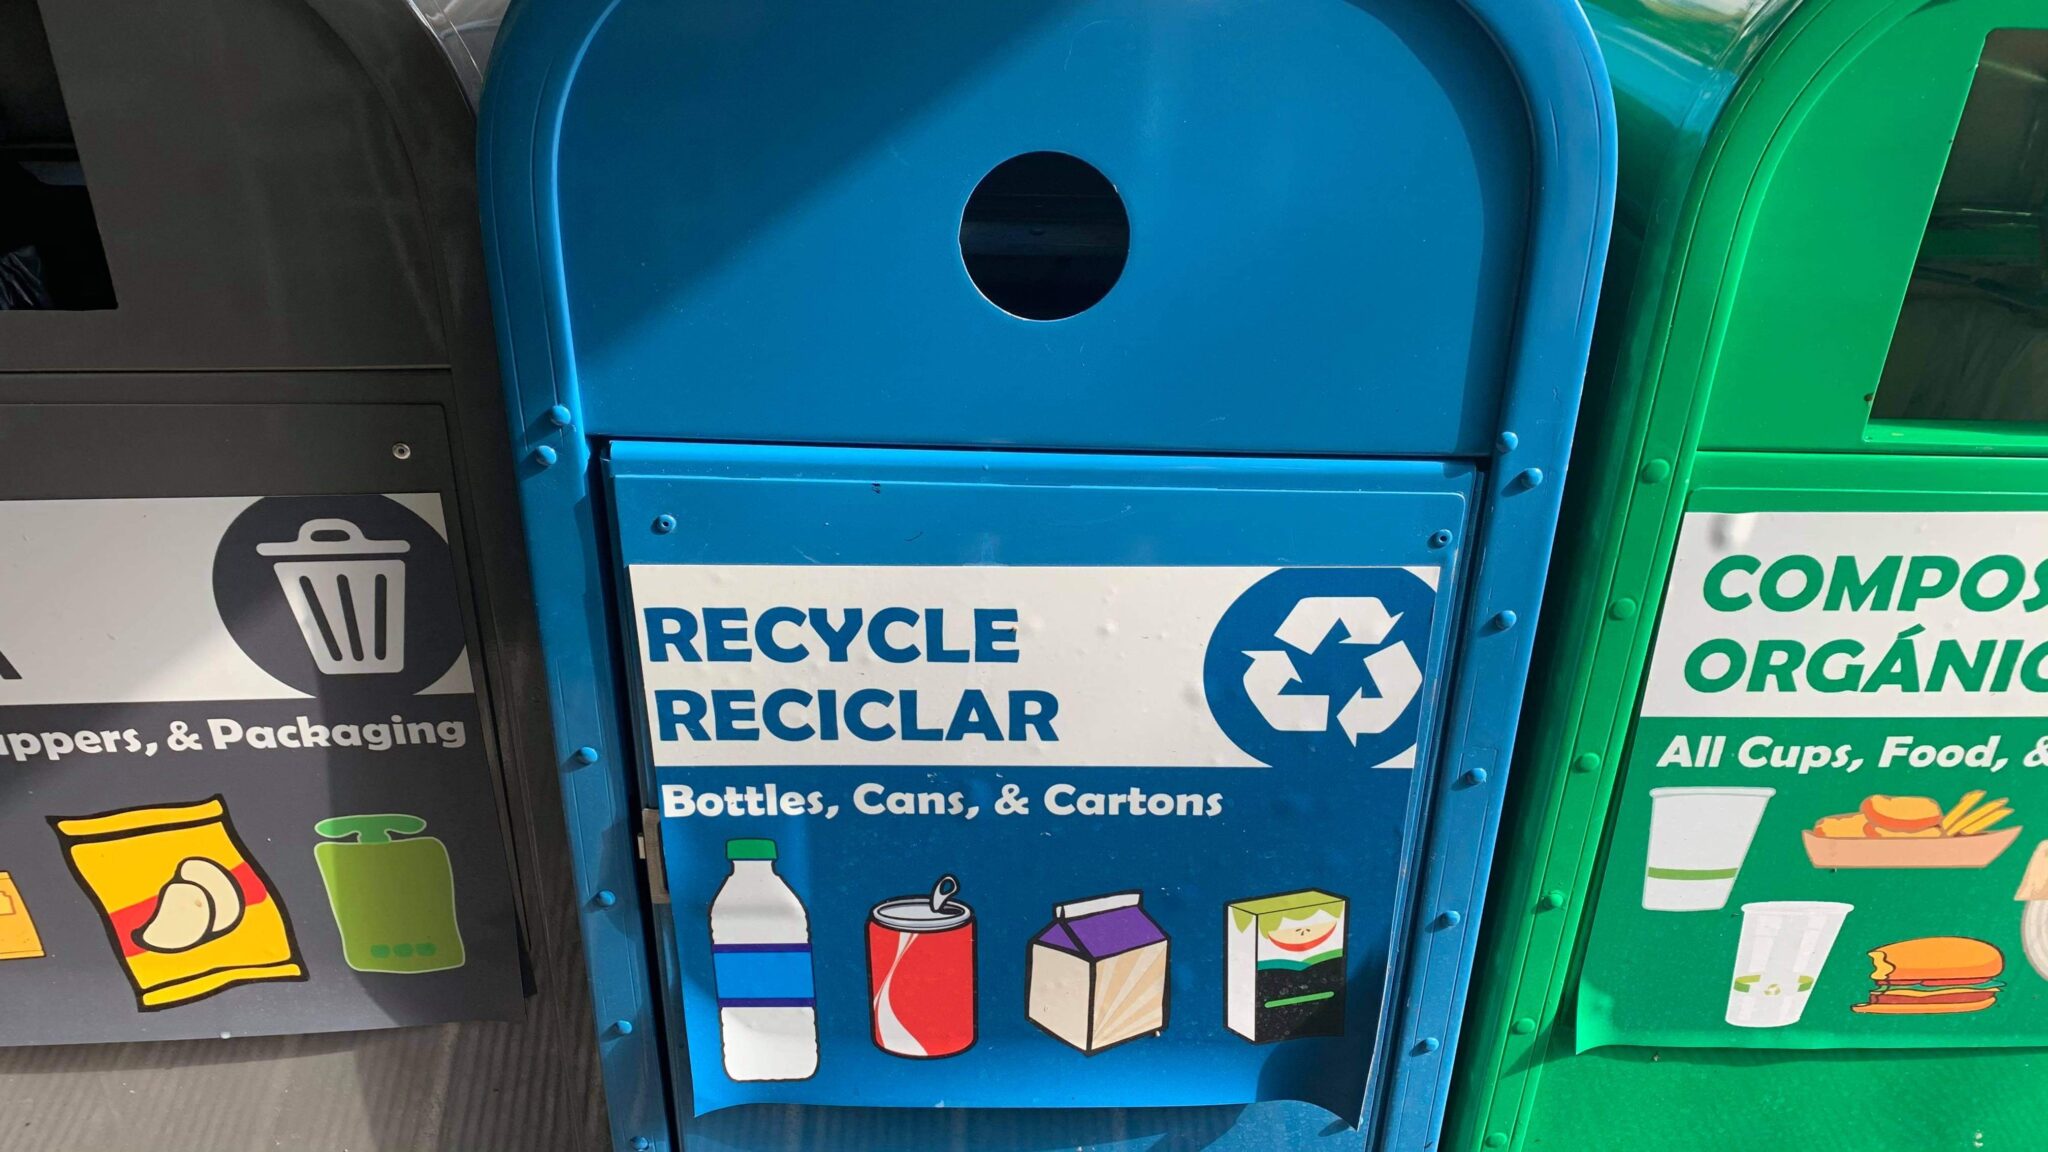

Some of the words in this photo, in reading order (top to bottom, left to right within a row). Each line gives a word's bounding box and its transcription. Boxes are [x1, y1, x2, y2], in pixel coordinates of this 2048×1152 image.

[644, 607, 1020, 663] RECYCLE
[0, 728, 158, 761] ppers,
[167, 721, 203, 751] &
[207, 715, 467, 751] Packaging
[655, 689, 1059, 742] RECICLAR
[1657, 735, 1726, 768] All
[1738, 735, 1863, 775] Cups,
[1878, 735, 2008, 773] Food,
[662, 784, 839, 819] Bottles,
[854, 782, 980, 819] Cans,
[994, 783, 1029, 816] &
[1043, 783, 1223, 817] Cartons
